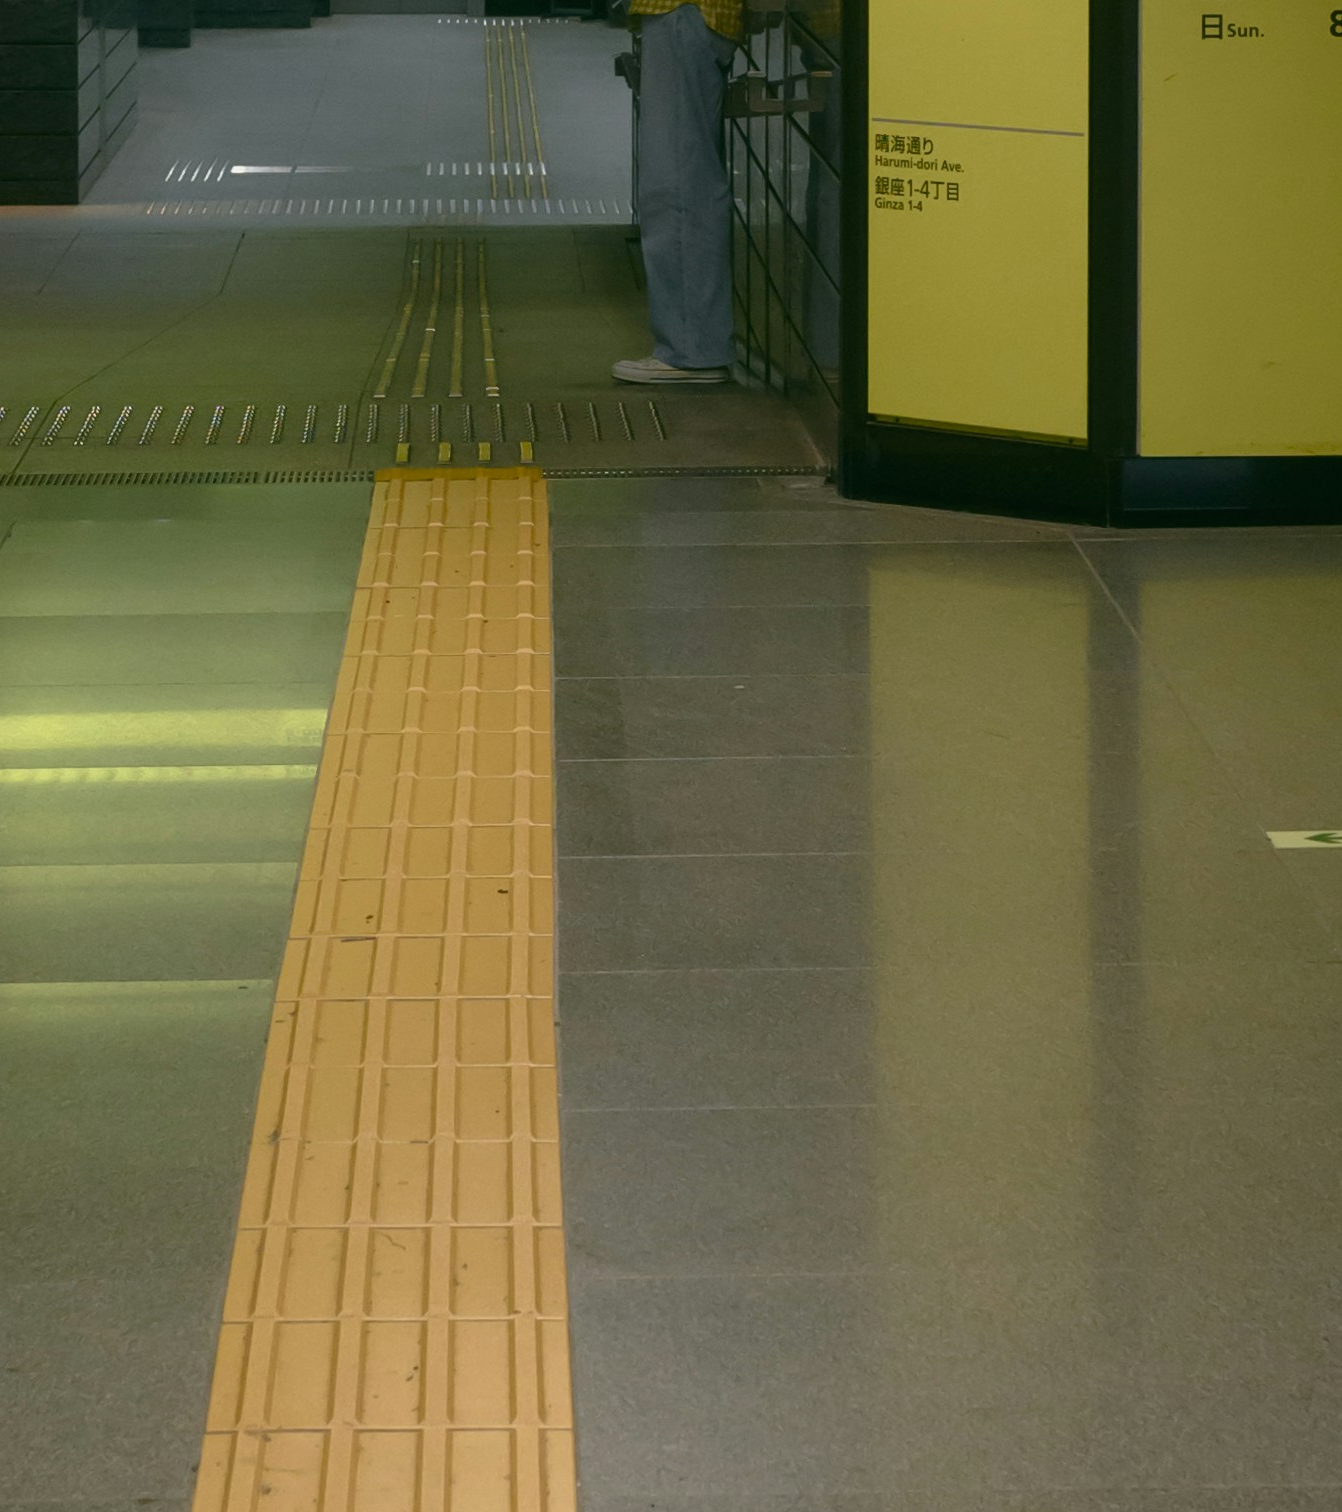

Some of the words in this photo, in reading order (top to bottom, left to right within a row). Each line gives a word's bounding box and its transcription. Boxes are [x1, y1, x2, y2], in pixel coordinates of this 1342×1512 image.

[1201, 14, 1223, 40] 日
[1227, 23, 1265, 38] Sun.
[875, 133, 934, 156] 晴海通り
[875, 155, 938, 171] Harumi-dori
[941, 160, 965, 173] Ave.
[875, 176, 960, 201] 銀座1-4丁目
[875, 197, 905, 211] Ginza
[908, 200, 924, 212] 1-4
